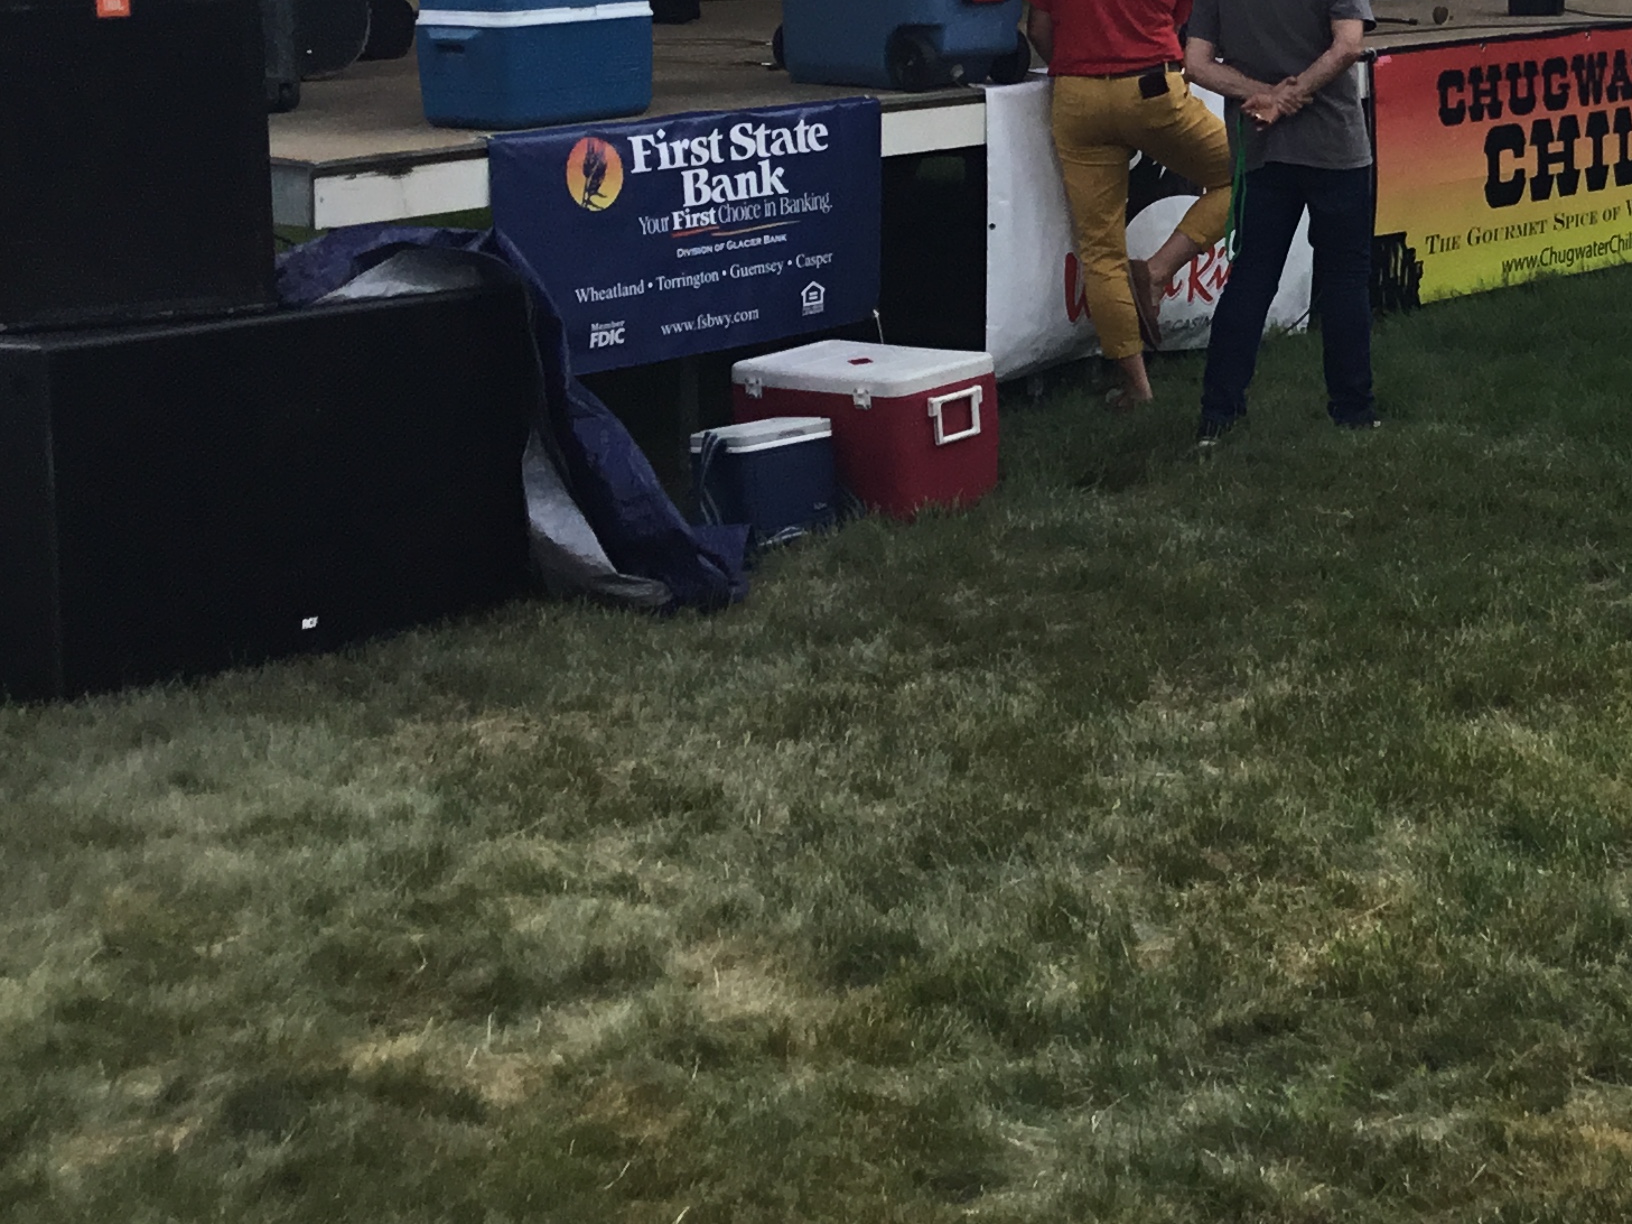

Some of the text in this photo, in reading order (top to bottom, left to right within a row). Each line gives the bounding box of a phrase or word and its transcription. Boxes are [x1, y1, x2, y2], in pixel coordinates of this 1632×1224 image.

[627, 118, 829, 174] First State
[680, 159, 789, 207] Bank
[638, 214, 669, 236] Your
[671, 207, 717, 231] First
[717, 202, 761, 224] Choice
[764, 199, 777, 217] in
[1425, 234, 1462, 255] THE
[1466, 219, 1548, 247] GOURMET
[1553, 210, 1599, 232] SPICE
[1602, 206, 1621, 222] OF
[575, 252, 834, 304] Wheatland Torrington Guernsey Casper
[589, 327, 626, 349] FDIC
[661, 308, 760, 336] www.fsbwy.com
